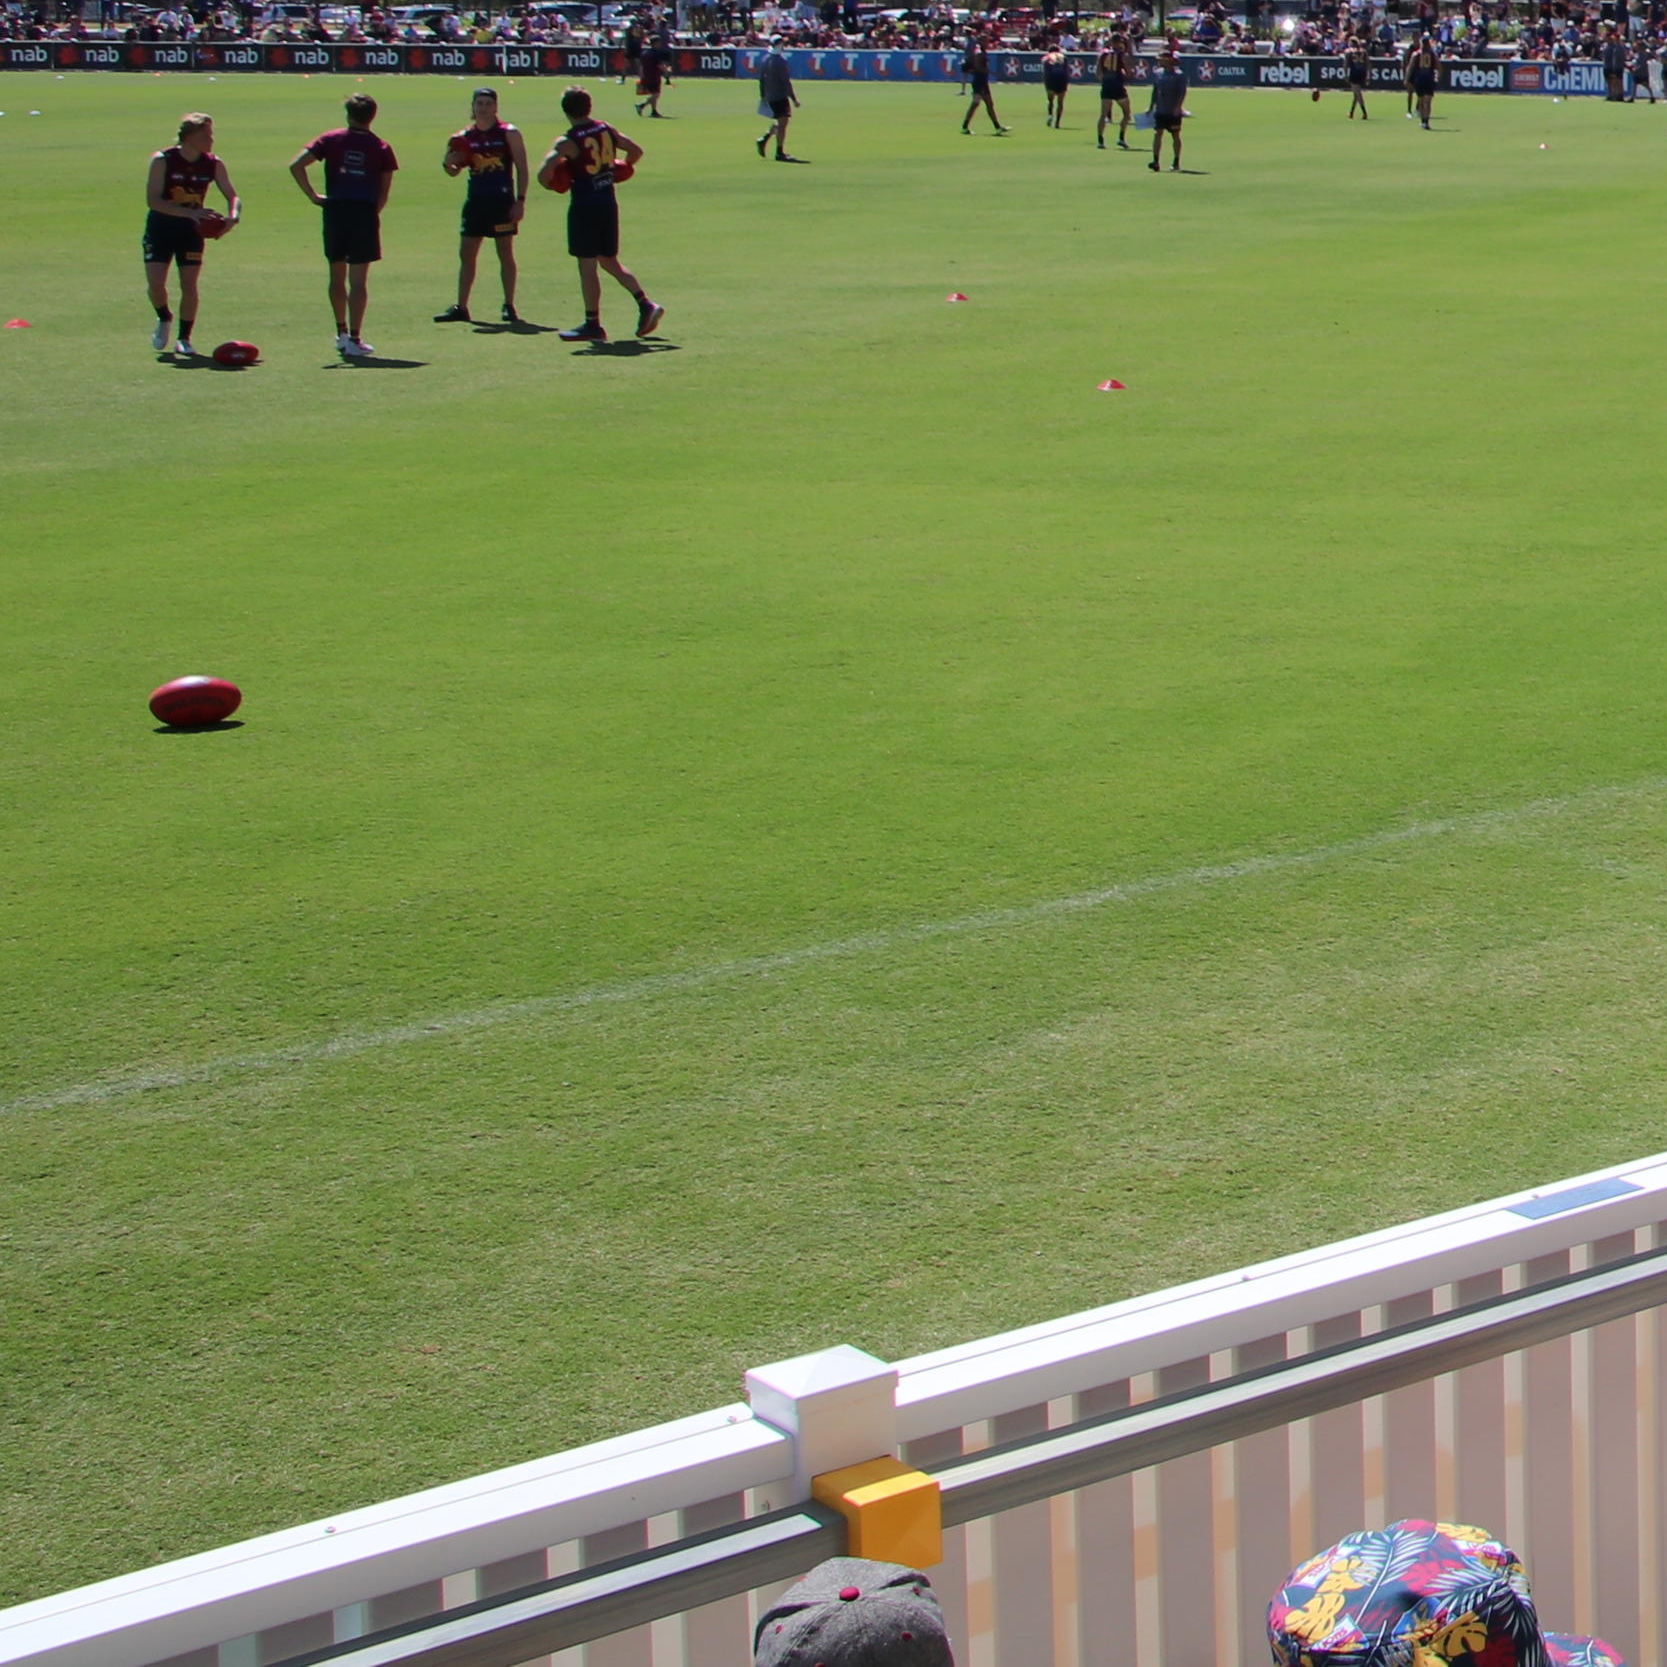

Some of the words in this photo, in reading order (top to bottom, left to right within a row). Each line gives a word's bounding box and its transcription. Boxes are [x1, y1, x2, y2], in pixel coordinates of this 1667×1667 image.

[11, 45, 48, 63] nab
[85, 45, 120, 64] nab
[154, 46, 188, 64] nab
[223, 46, 259, 65] nab
[294, 47, 329, 66] nab
[365, 48, 399, 66] nab
[432, 48, 466, 67] nab
[567, 50, 600, 69] nab
[701, 52, 732, 70] nab
[1217, 66, 1247, 77] CALTEX
[1259, 61, 1310, 84] rebel
[1450, 65, 1504, 89] rebel
[584, 130, 615, 175] 34
